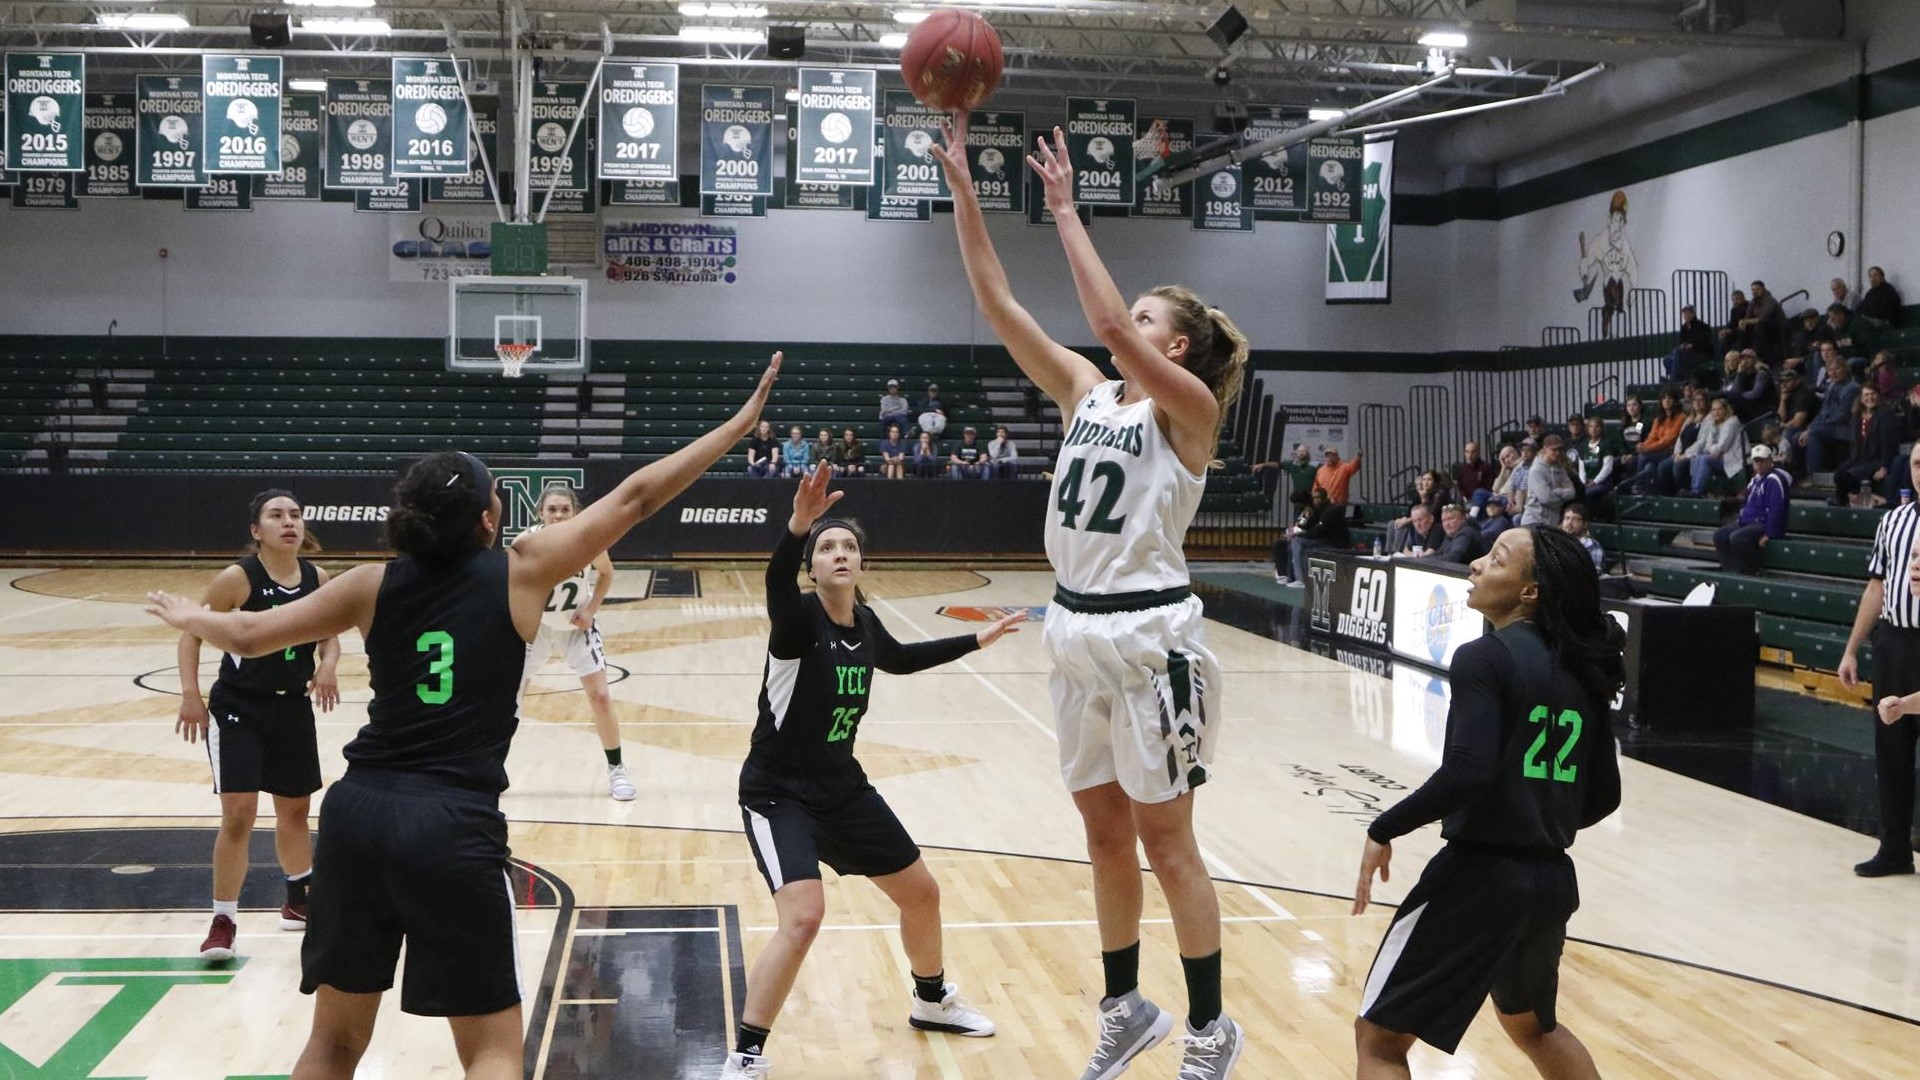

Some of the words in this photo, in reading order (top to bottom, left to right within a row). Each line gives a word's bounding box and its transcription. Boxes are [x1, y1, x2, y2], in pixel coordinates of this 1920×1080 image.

[9, 79, 81, 94] OREDIGGERS
[206, 82, 279, 97] OREDIGGERS
[395, 85, 464, 100] OREDIGGER
[603, 89, 674, 104] OREDIGGERS
[802, 94, 872, 109] OREDIGGERS
[140, 99, 203, 113] OREDIGGER
[329, 102, 392, 116] OREDIGGER
[532, 105, 585, 119] EDIGGER
[85, 116, 135, 129] REDIGGER
[704, 109, 771, 123] OREDIGGERS
[282, 119, 318, 131] IGGERS
[1069, 121, 1133, 135] OREDIGGERS
[21, 134, 68, 151] 2015
[219, 136, 267, 154] 2016
[408, 139, 454, 156] 2016
[616, 142, 660, 159] 2017
[814, 147, 858, 163] 2017
[1311, 145, 1362, 159] REDIGGERS
[21, 157, 69, 166] CHAMPIONS
[152, 151, 195, 167] 1997
[219, 160, 266, 169] CHAMPIONS
[341, 153, 384, 169] 1998
[530, 156, 573, 172] 1999
[88, 165, 129, 180] 1985
[716, 160, 758, 176] 2000
[897, 164, 939, 181] 2001
[26, 178, 65, 192] 1979
[151, 174, 195, 182] CHAMPIONS
[340, 176, 384, 184] CHAMPIONS
[530, 179, 573, 187] CHAMONS
[715, 181, 758, 189] CHAMPIONS
[1079, 170, 1122, 187] 2004
[1253, 177, 1294, 193] 2012
[88, 186, 129, 194] CHAMPIONS
[264, 188, 306, 196] CHAMPIONS
[897, 186, 939, 194] CHAMPIONS
[973, 181, 1011, 195] 1991
[25, 198, 65, 206] CHAMPIONS
[198, 199, 238, 207] CHAMPIONS
[799, 197, 839, 205] CHAMPIONS
[1079, 192, 1121, 200] CHAMPIONS
[1253, 198, 1294, 207] CHAMPIONS
[1313, 192, 1350, 206] 1992
[369, 201, 408, 209] CHAMPIONS
[1206, 202, 1241, 216] 1983
[880, 210, 918, 218] CHAMPIONS
[1312, 211, 1350, 219] CHAMPIONS
[419, 216, 484, 243] Quilici
[632, 223, 711, 235] MIDTOWN
[1205, 220, 1241, 228] CHAMPIONS
[393, 241, 492, 258] GLAS
[653, 239, 667, 252] &
[624, 271, 650, 281] 926
[667, 271, 718, 282] Arizona
[1058, 457, 1127, 534] 42
[303, 506, 390, 522] DIGGERS
[681, 507, 767, 523] DIGGERS
[1350, 567, 1388, 622] GO
[1337, 612, 1388, 645] DIGGERS
[416, 631, 454, 705] 3
[836, 666, 866, 695] YCC
[827, 707, 860, 743] 25
[1523, 704, 1583, 783] 22
